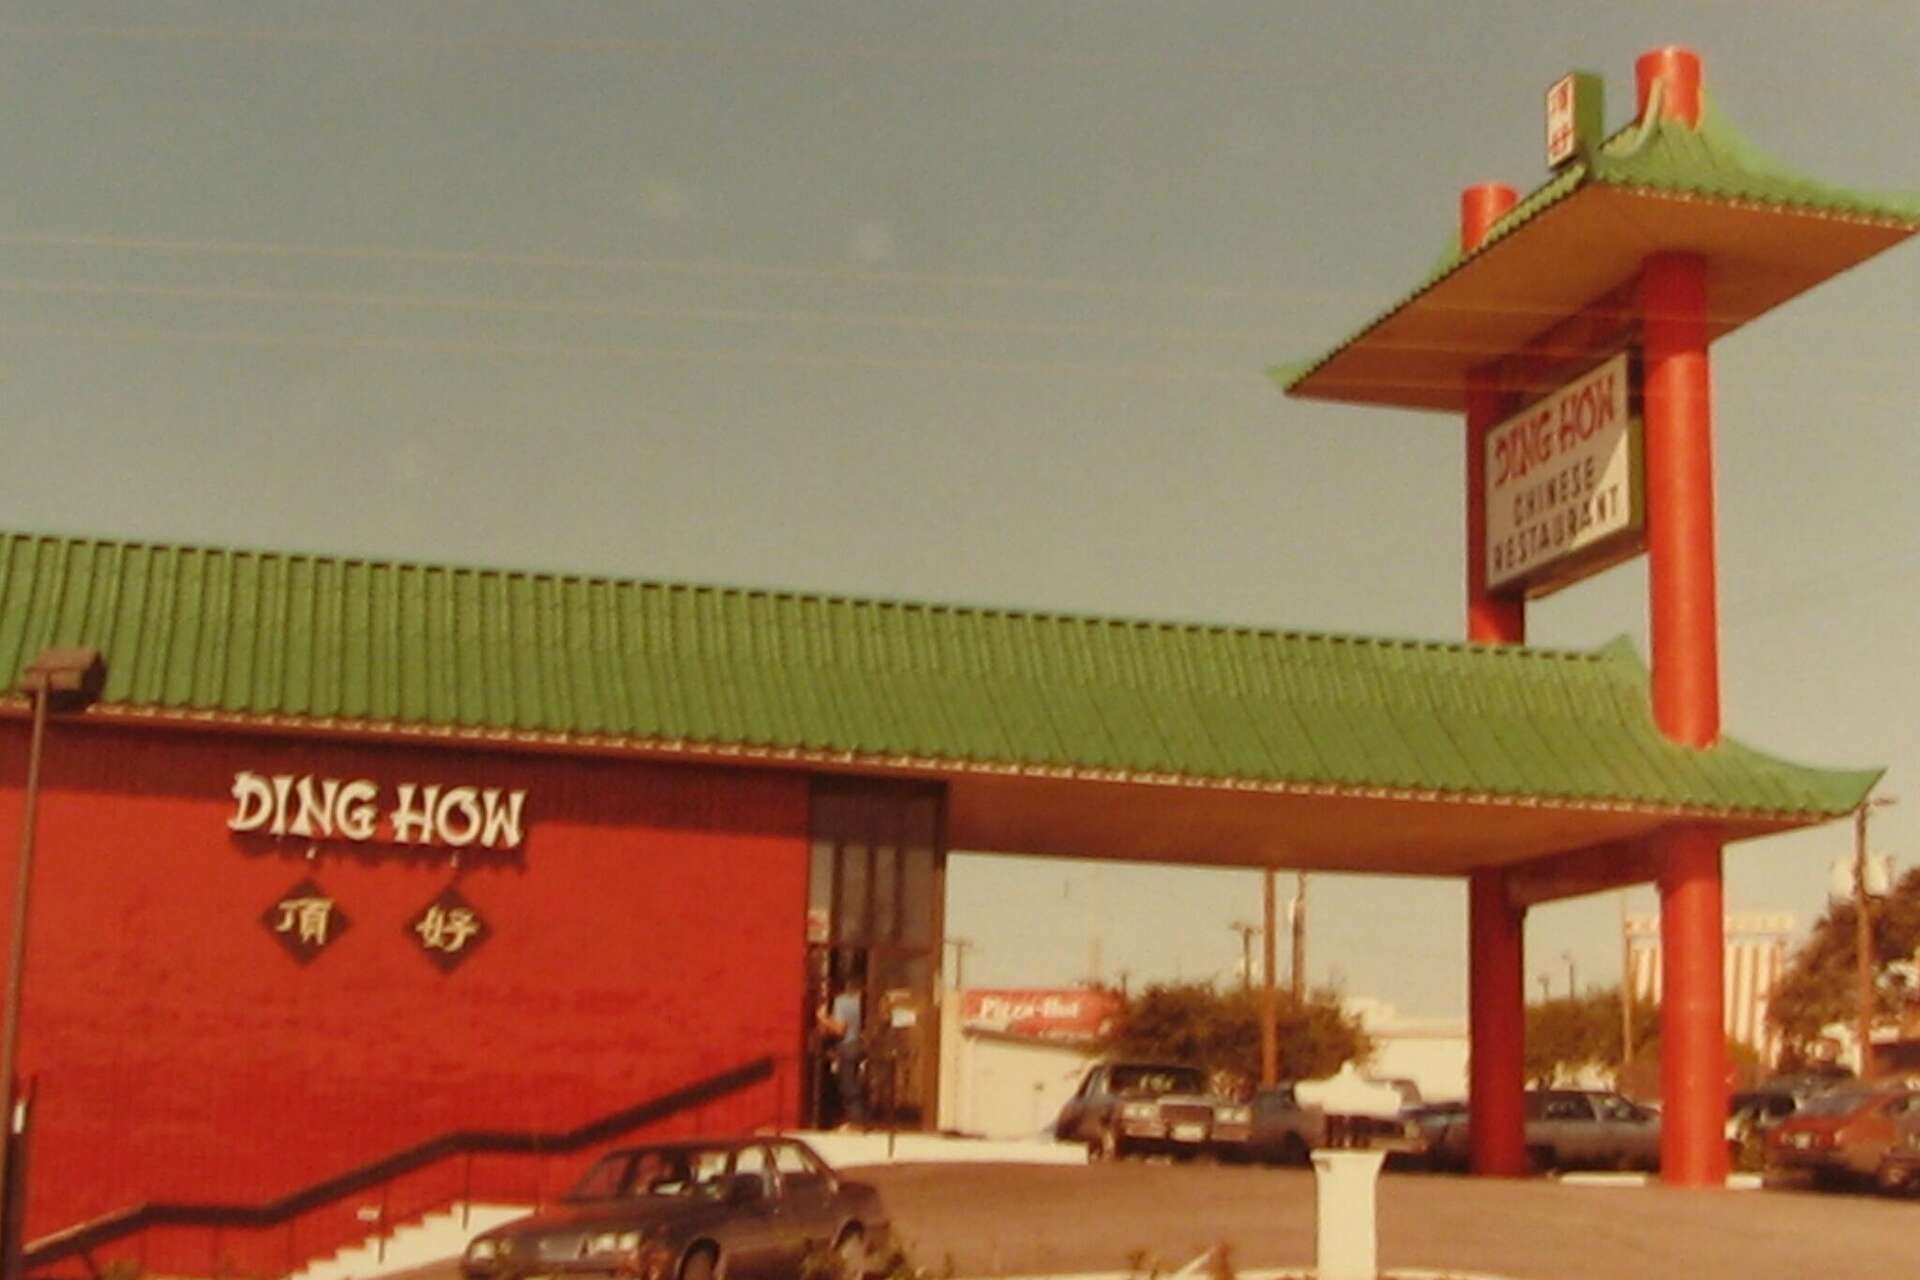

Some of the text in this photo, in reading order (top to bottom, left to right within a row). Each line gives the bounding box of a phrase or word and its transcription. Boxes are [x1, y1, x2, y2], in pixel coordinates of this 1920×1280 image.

[1495, 374, 1615, 487] DING HOW
[1495, 484, 1618, 569] RESTAURANT
[1514, 455, 1593, 526] CHINESE
[227, 771, 526, 848] DING HOW
[276, 897, 481, 952] 頂 好
